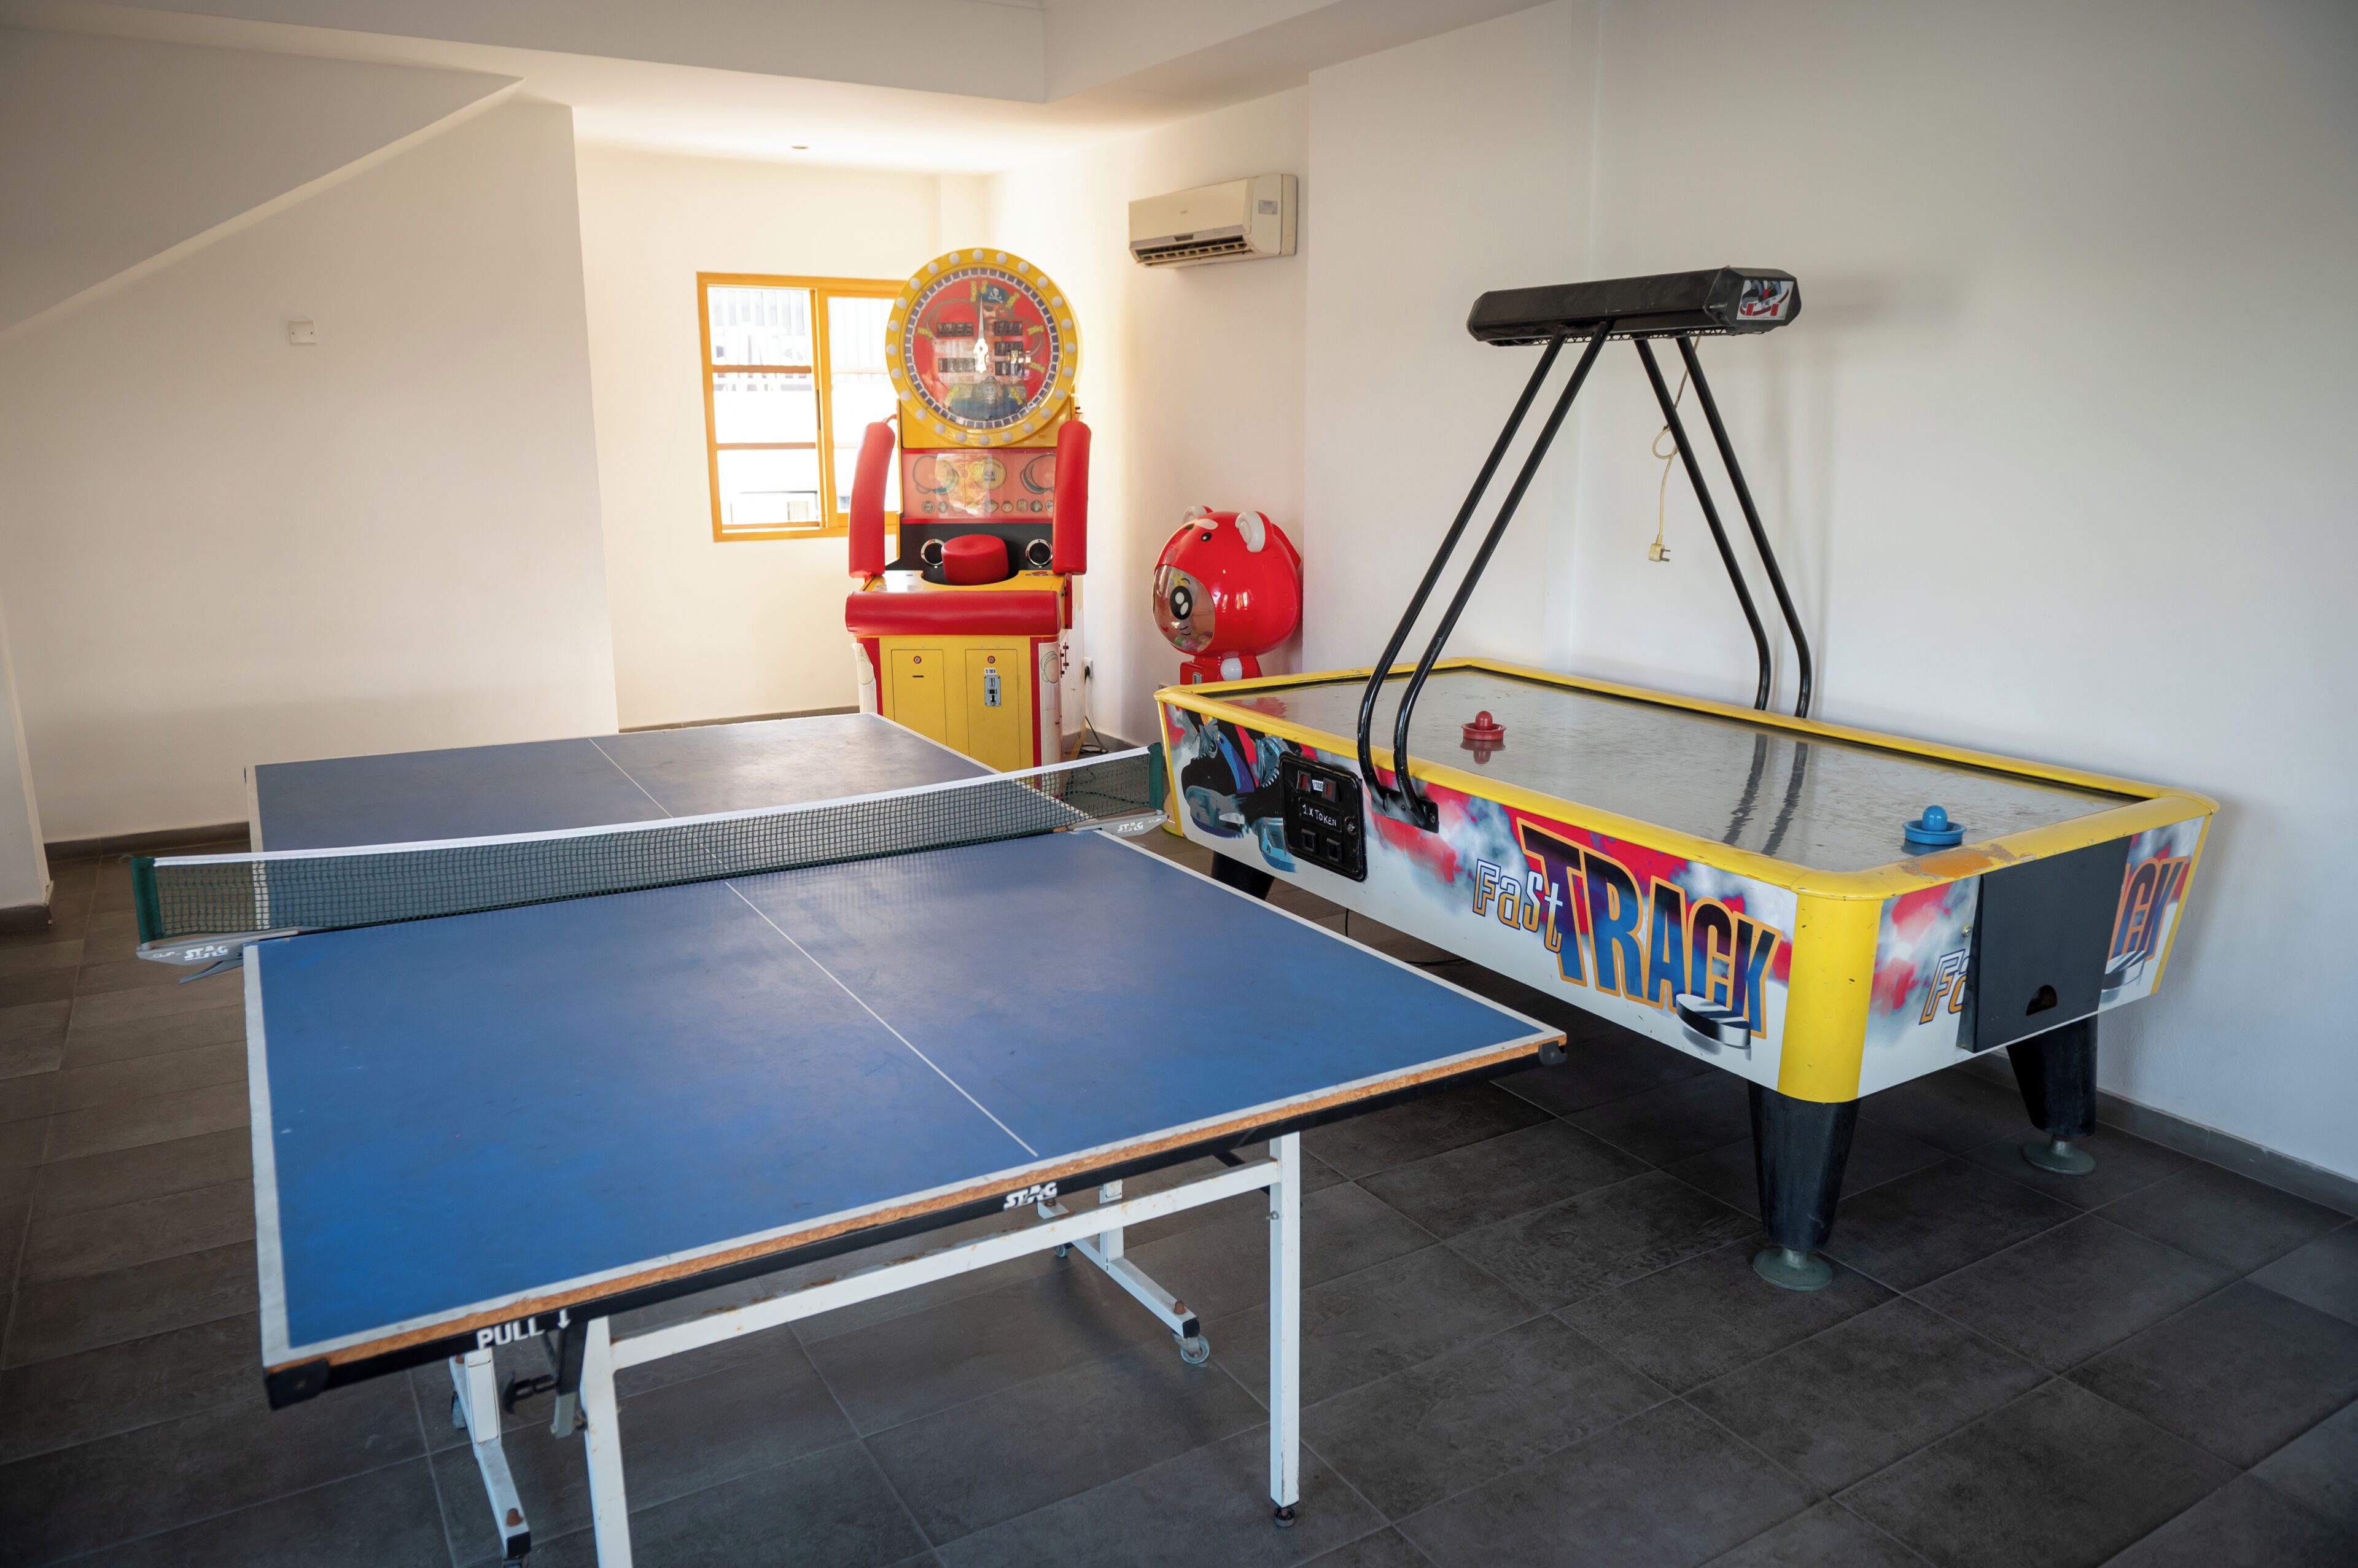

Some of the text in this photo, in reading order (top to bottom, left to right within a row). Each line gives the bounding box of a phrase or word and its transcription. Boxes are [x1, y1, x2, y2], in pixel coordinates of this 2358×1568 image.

[1117, 821, 1144, 833] STAG
[1315, 809, 1337, 826] TOKEN
[1516, 817, 1781, 1039] TRACK
[184, 945, 228, 961] STAG
[1003, 1182, 1057, 1211] STAG
[477, 1317, 545, 1350] PULL
